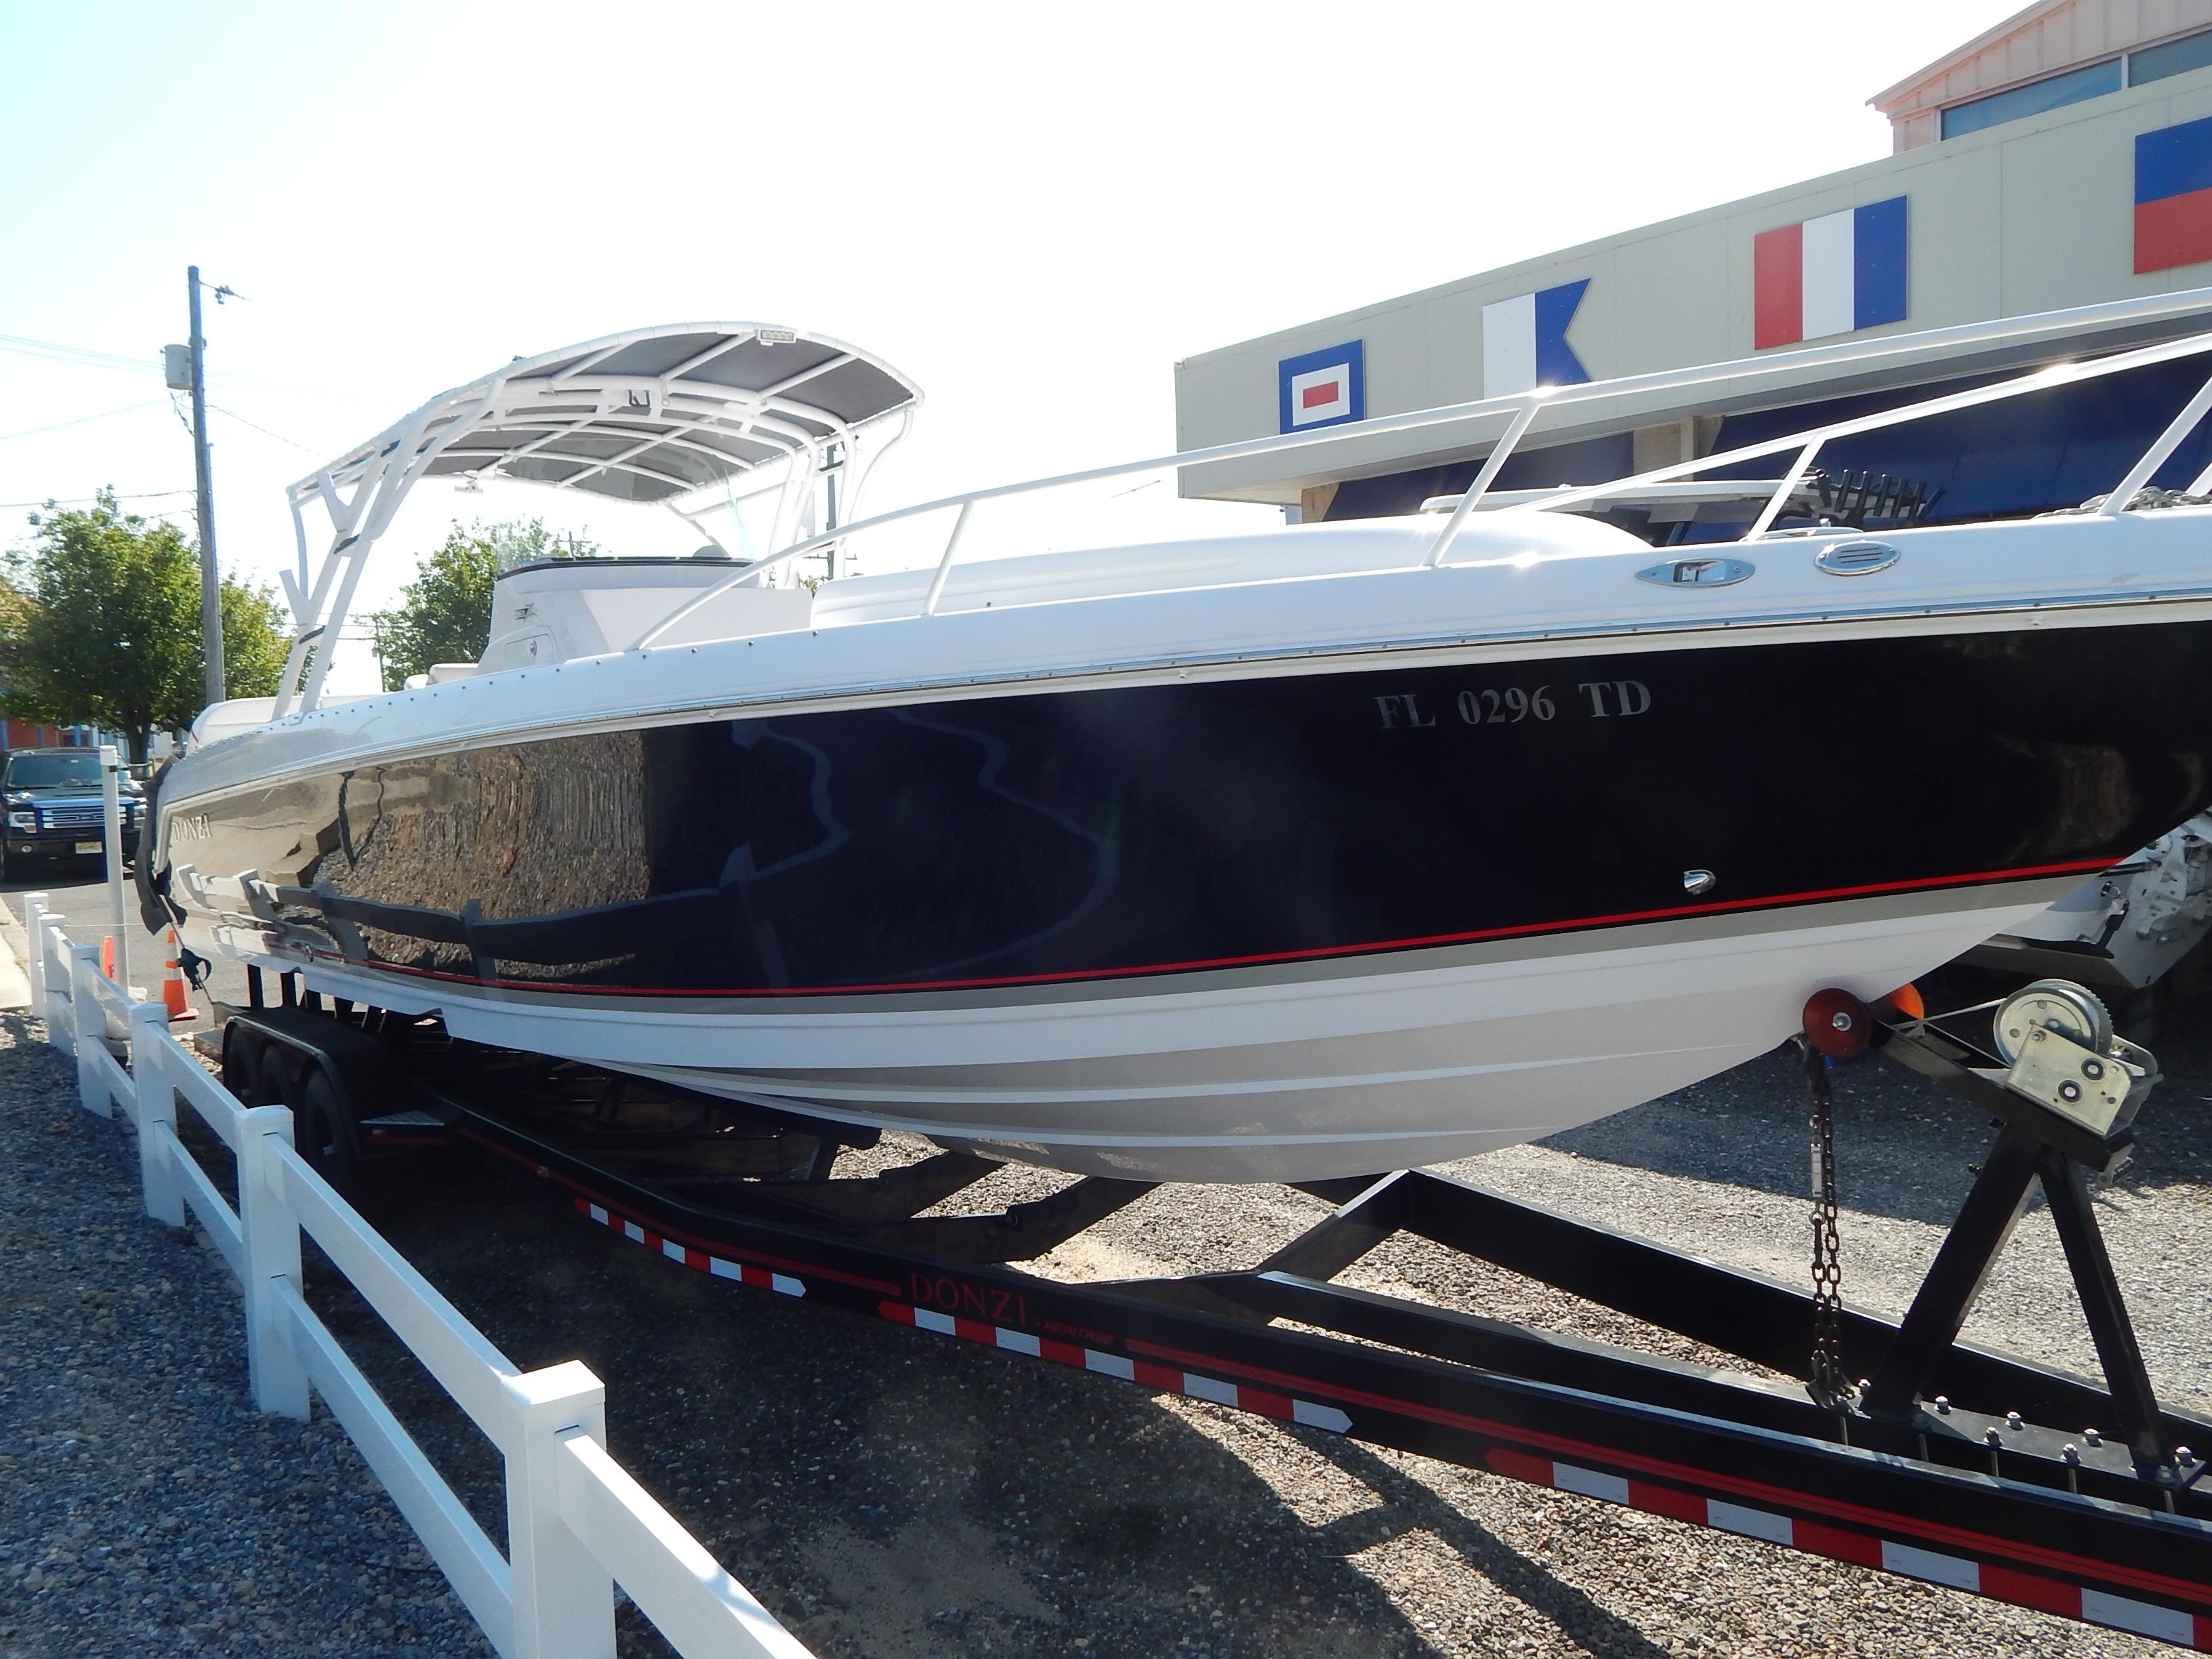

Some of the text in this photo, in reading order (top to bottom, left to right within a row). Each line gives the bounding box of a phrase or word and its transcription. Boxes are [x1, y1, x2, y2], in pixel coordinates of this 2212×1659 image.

[1373, 680, 1652, 729] FL 0296 TD
[171, 814, 212, 842] DONZI
[911, 1271, 1027, 1326] DONZI
